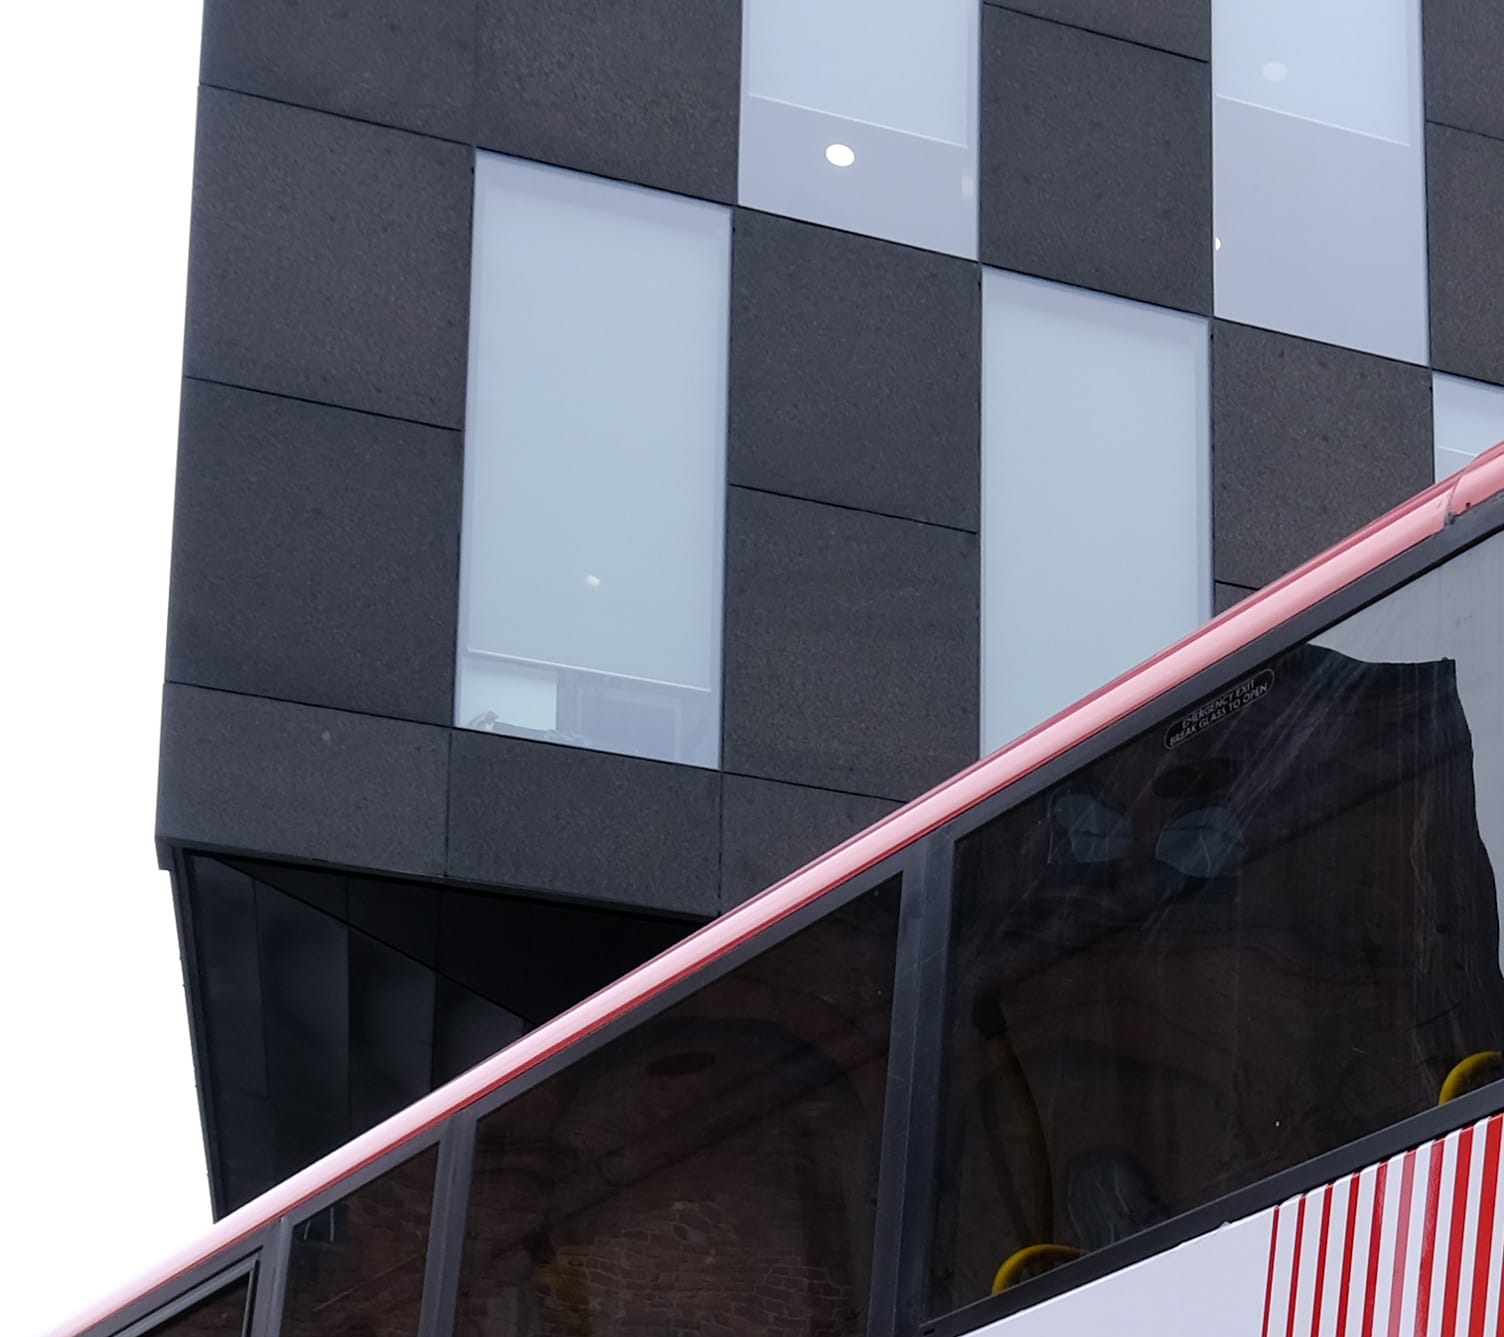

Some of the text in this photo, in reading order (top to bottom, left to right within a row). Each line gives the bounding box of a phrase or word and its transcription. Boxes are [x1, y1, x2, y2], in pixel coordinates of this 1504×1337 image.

[1199, 708, 1227, 728] GLASS
[1228, 701, 1241, 714] TO
[1243, 682, 1268, 703] OPEN
